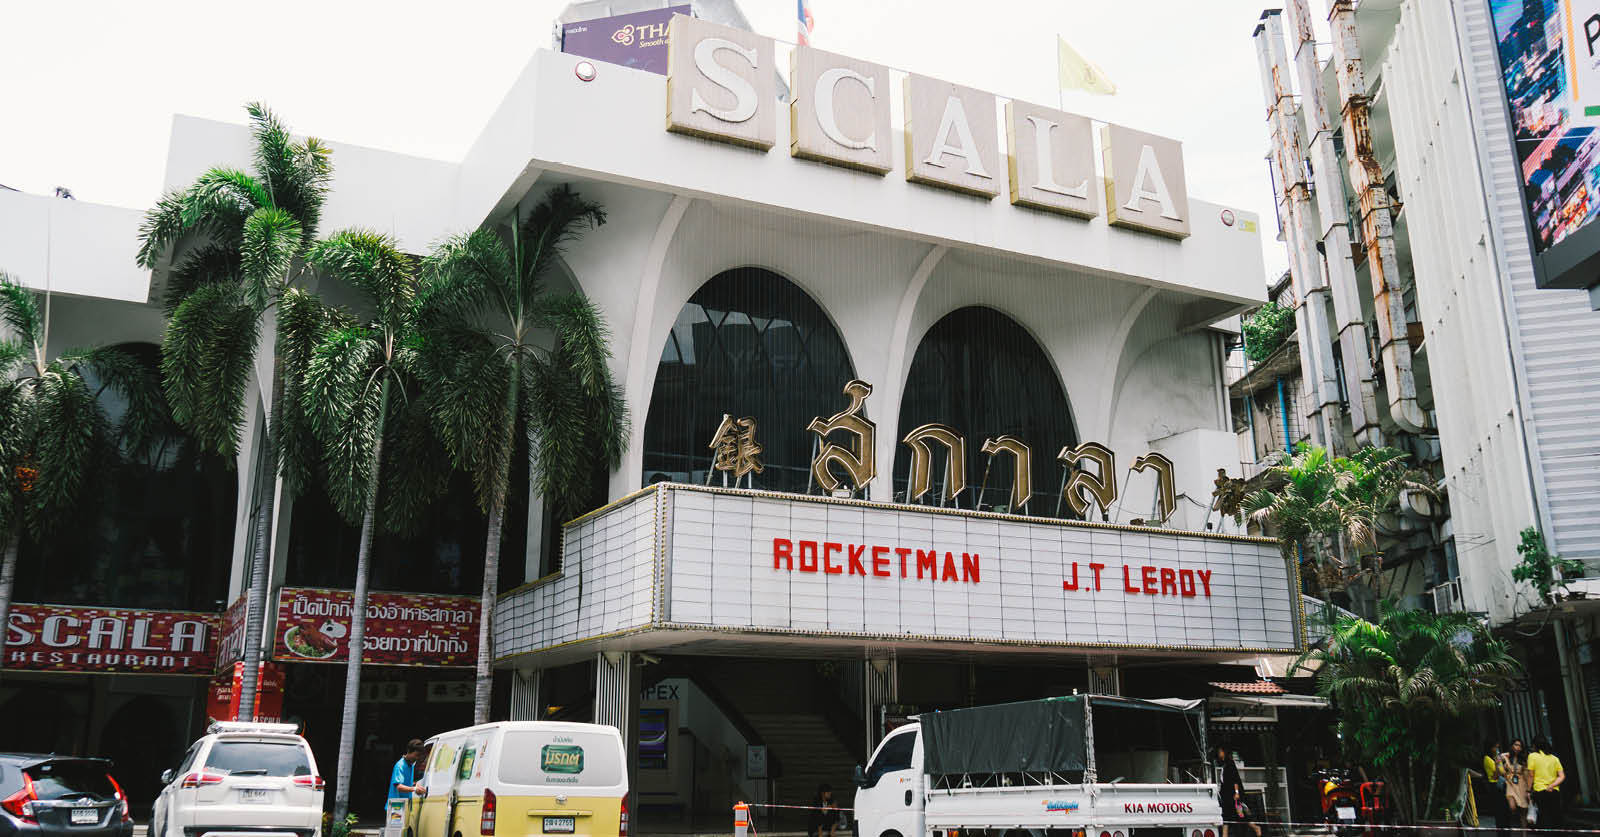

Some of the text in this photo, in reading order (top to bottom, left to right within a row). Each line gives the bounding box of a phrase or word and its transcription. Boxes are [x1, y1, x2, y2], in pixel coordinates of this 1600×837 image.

[692, 37, 1183, 222] SCALA
[807, 379, 1177, 523] สกาลา
[773, 538, 980, 583] ROCKETMAN
[1063, 562, 1213, 598] J.T LEROY
[5, 613, 207, 652] SCALA
[11, 651, 193, 668] RESTAURANT
[1124, 803, 1193, 814] KIA MOTORS
